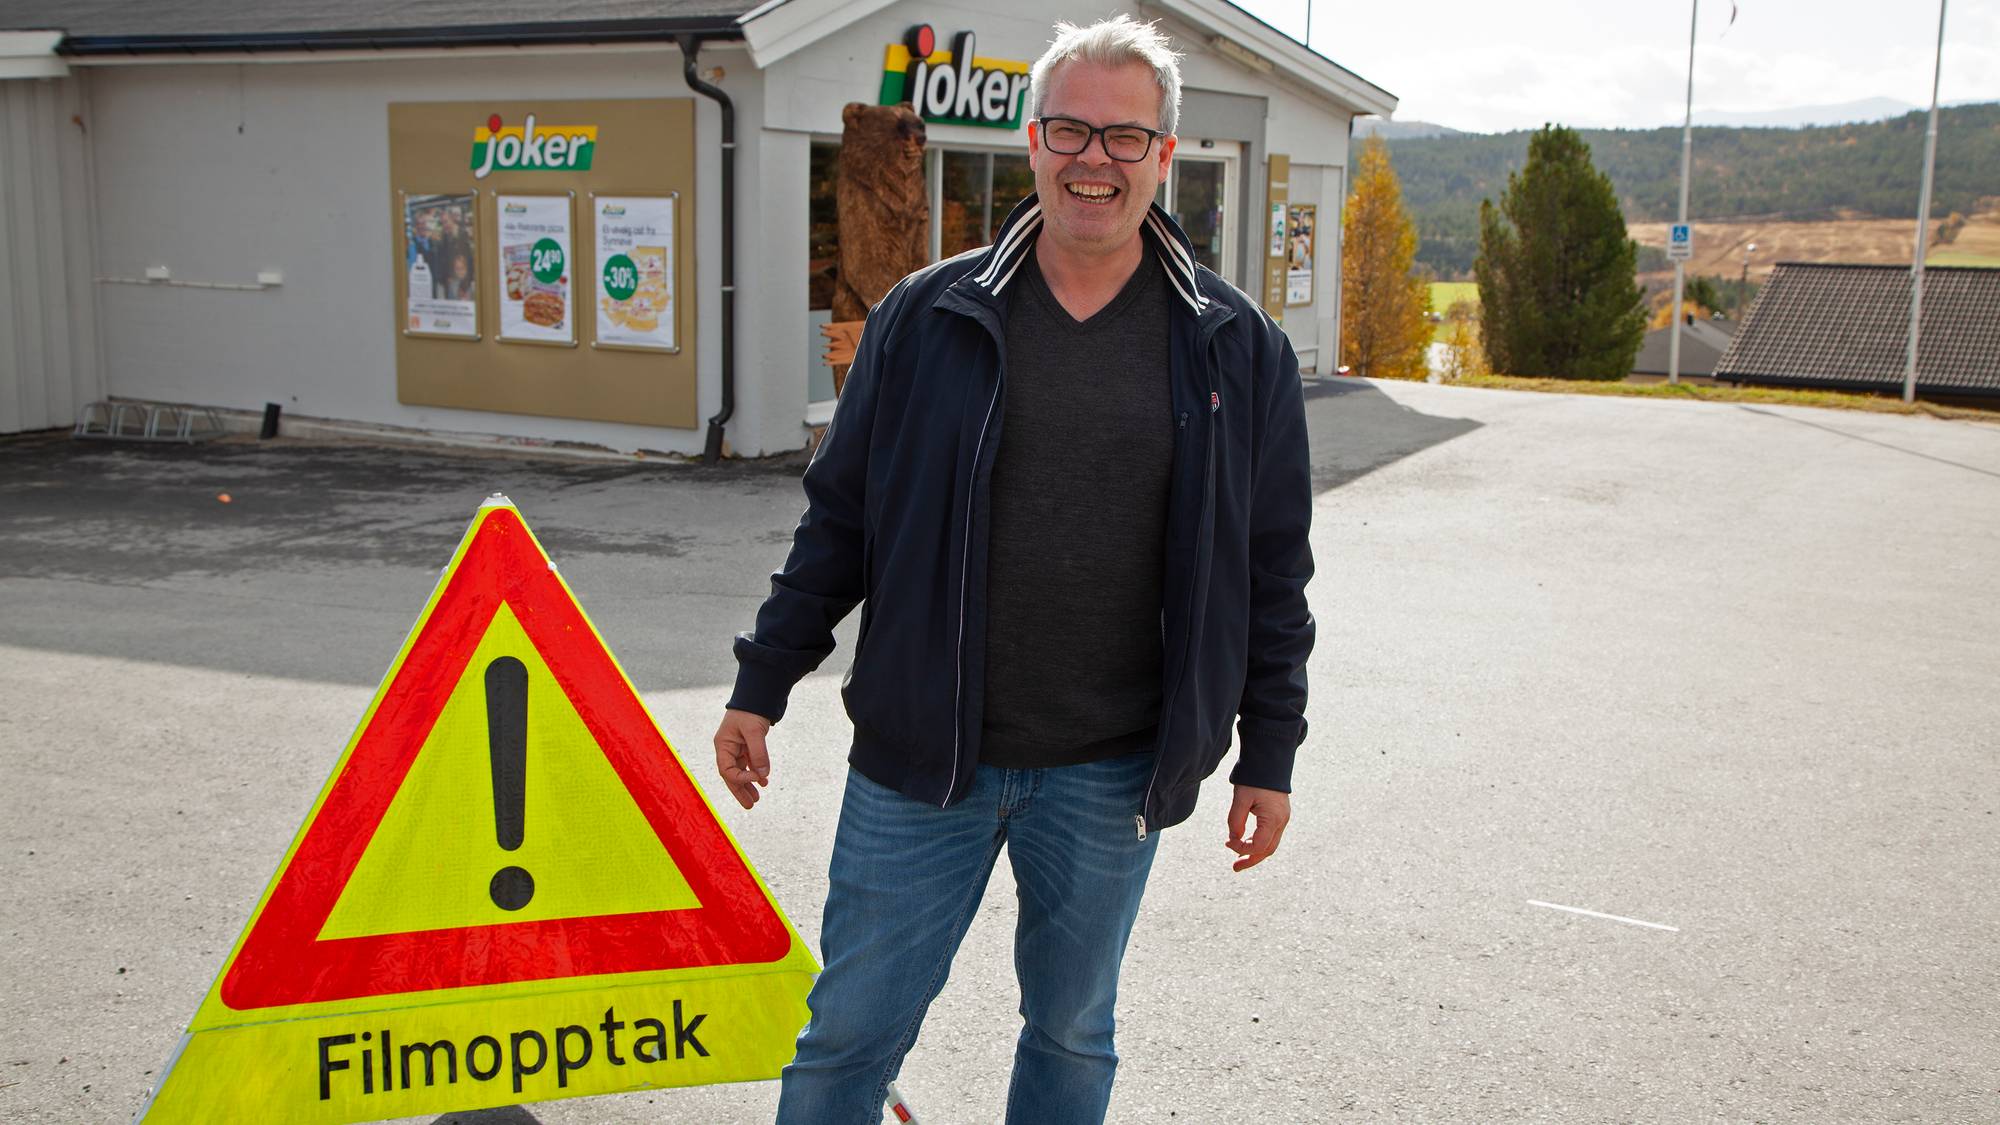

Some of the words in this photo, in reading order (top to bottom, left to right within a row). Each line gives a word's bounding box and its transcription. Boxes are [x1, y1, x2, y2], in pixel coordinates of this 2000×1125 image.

[907, 24, 1030, 121] joker
[474, 113, 587, 178] joker
[603, 266, 635, 289] -30%
[317, 1000, 711, 1100] Filmopptak
